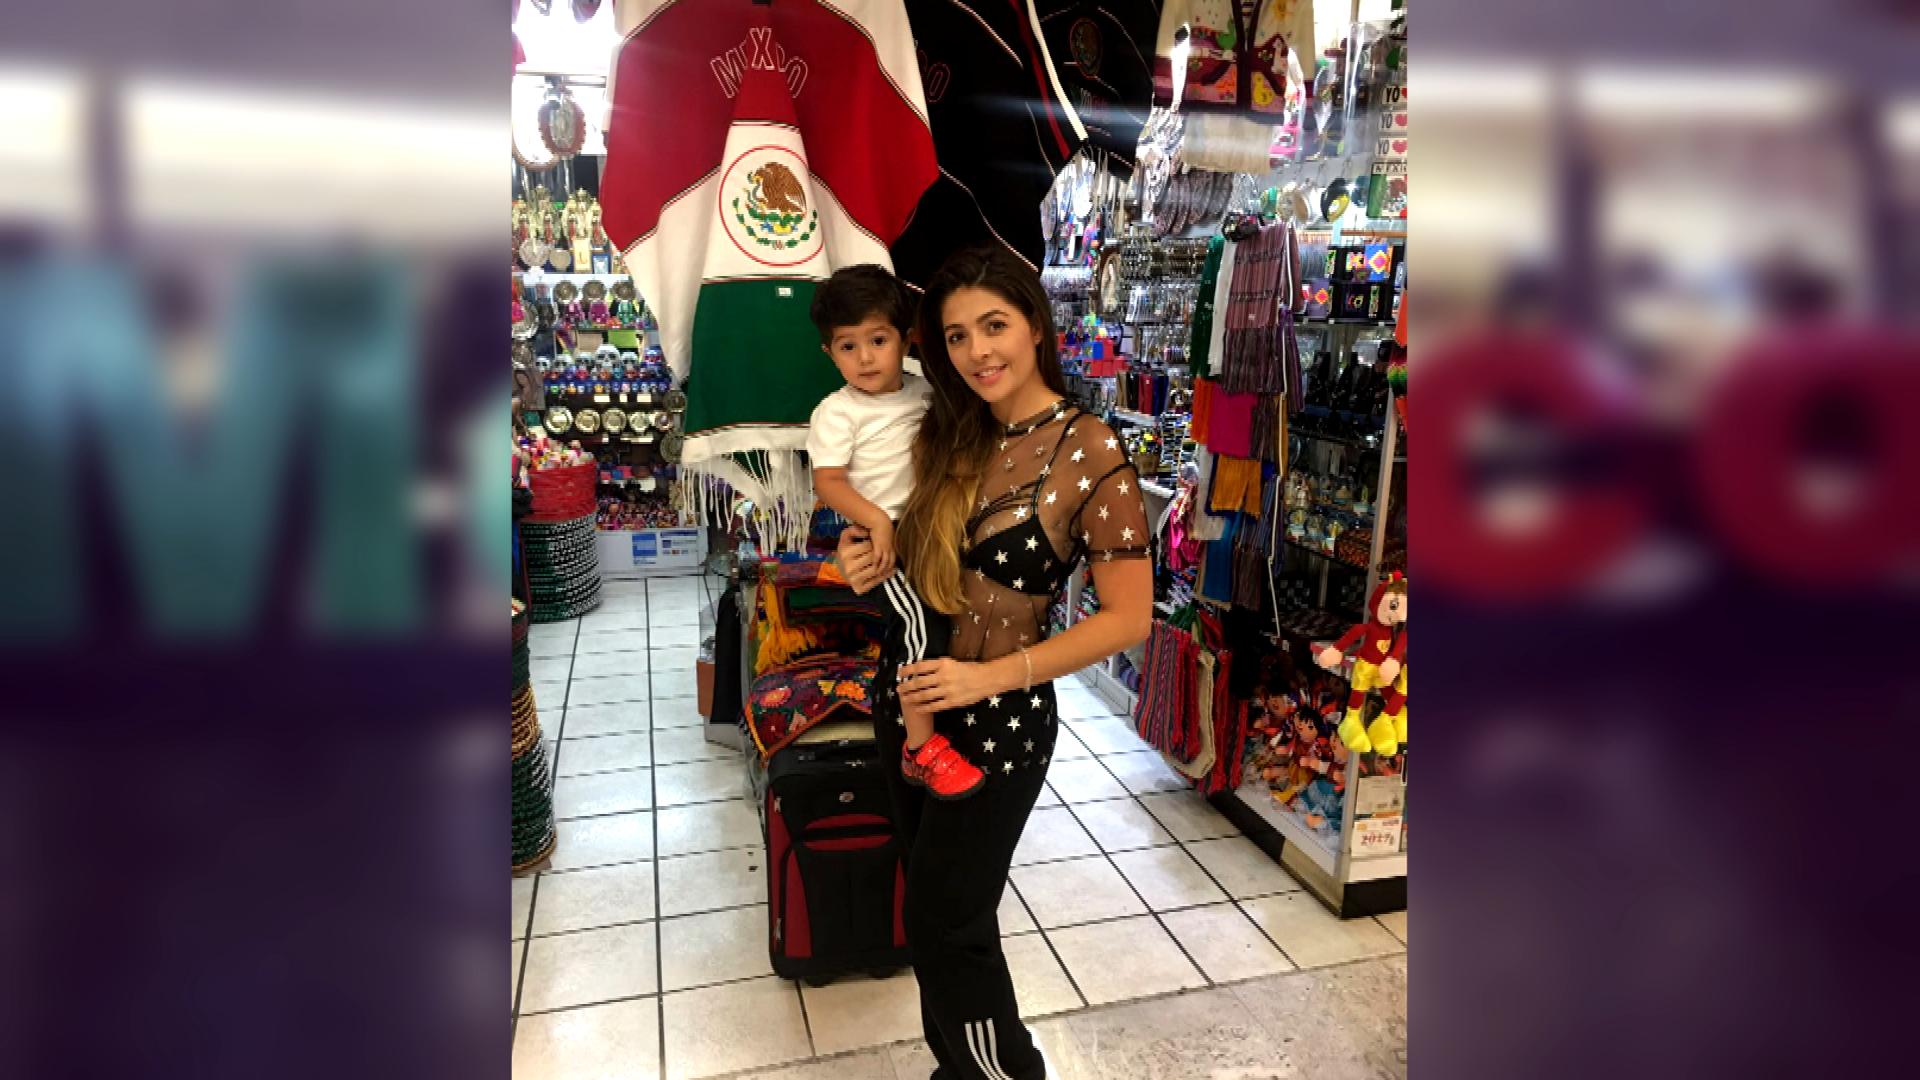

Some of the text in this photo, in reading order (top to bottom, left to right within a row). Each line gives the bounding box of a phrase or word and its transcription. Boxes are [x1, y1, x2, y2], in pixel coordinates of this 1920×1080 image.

[1386, 87, 1400, 102] YO
[1381, 114, 1392, 129] YO
[1377, 140, 1389, 155] YO
